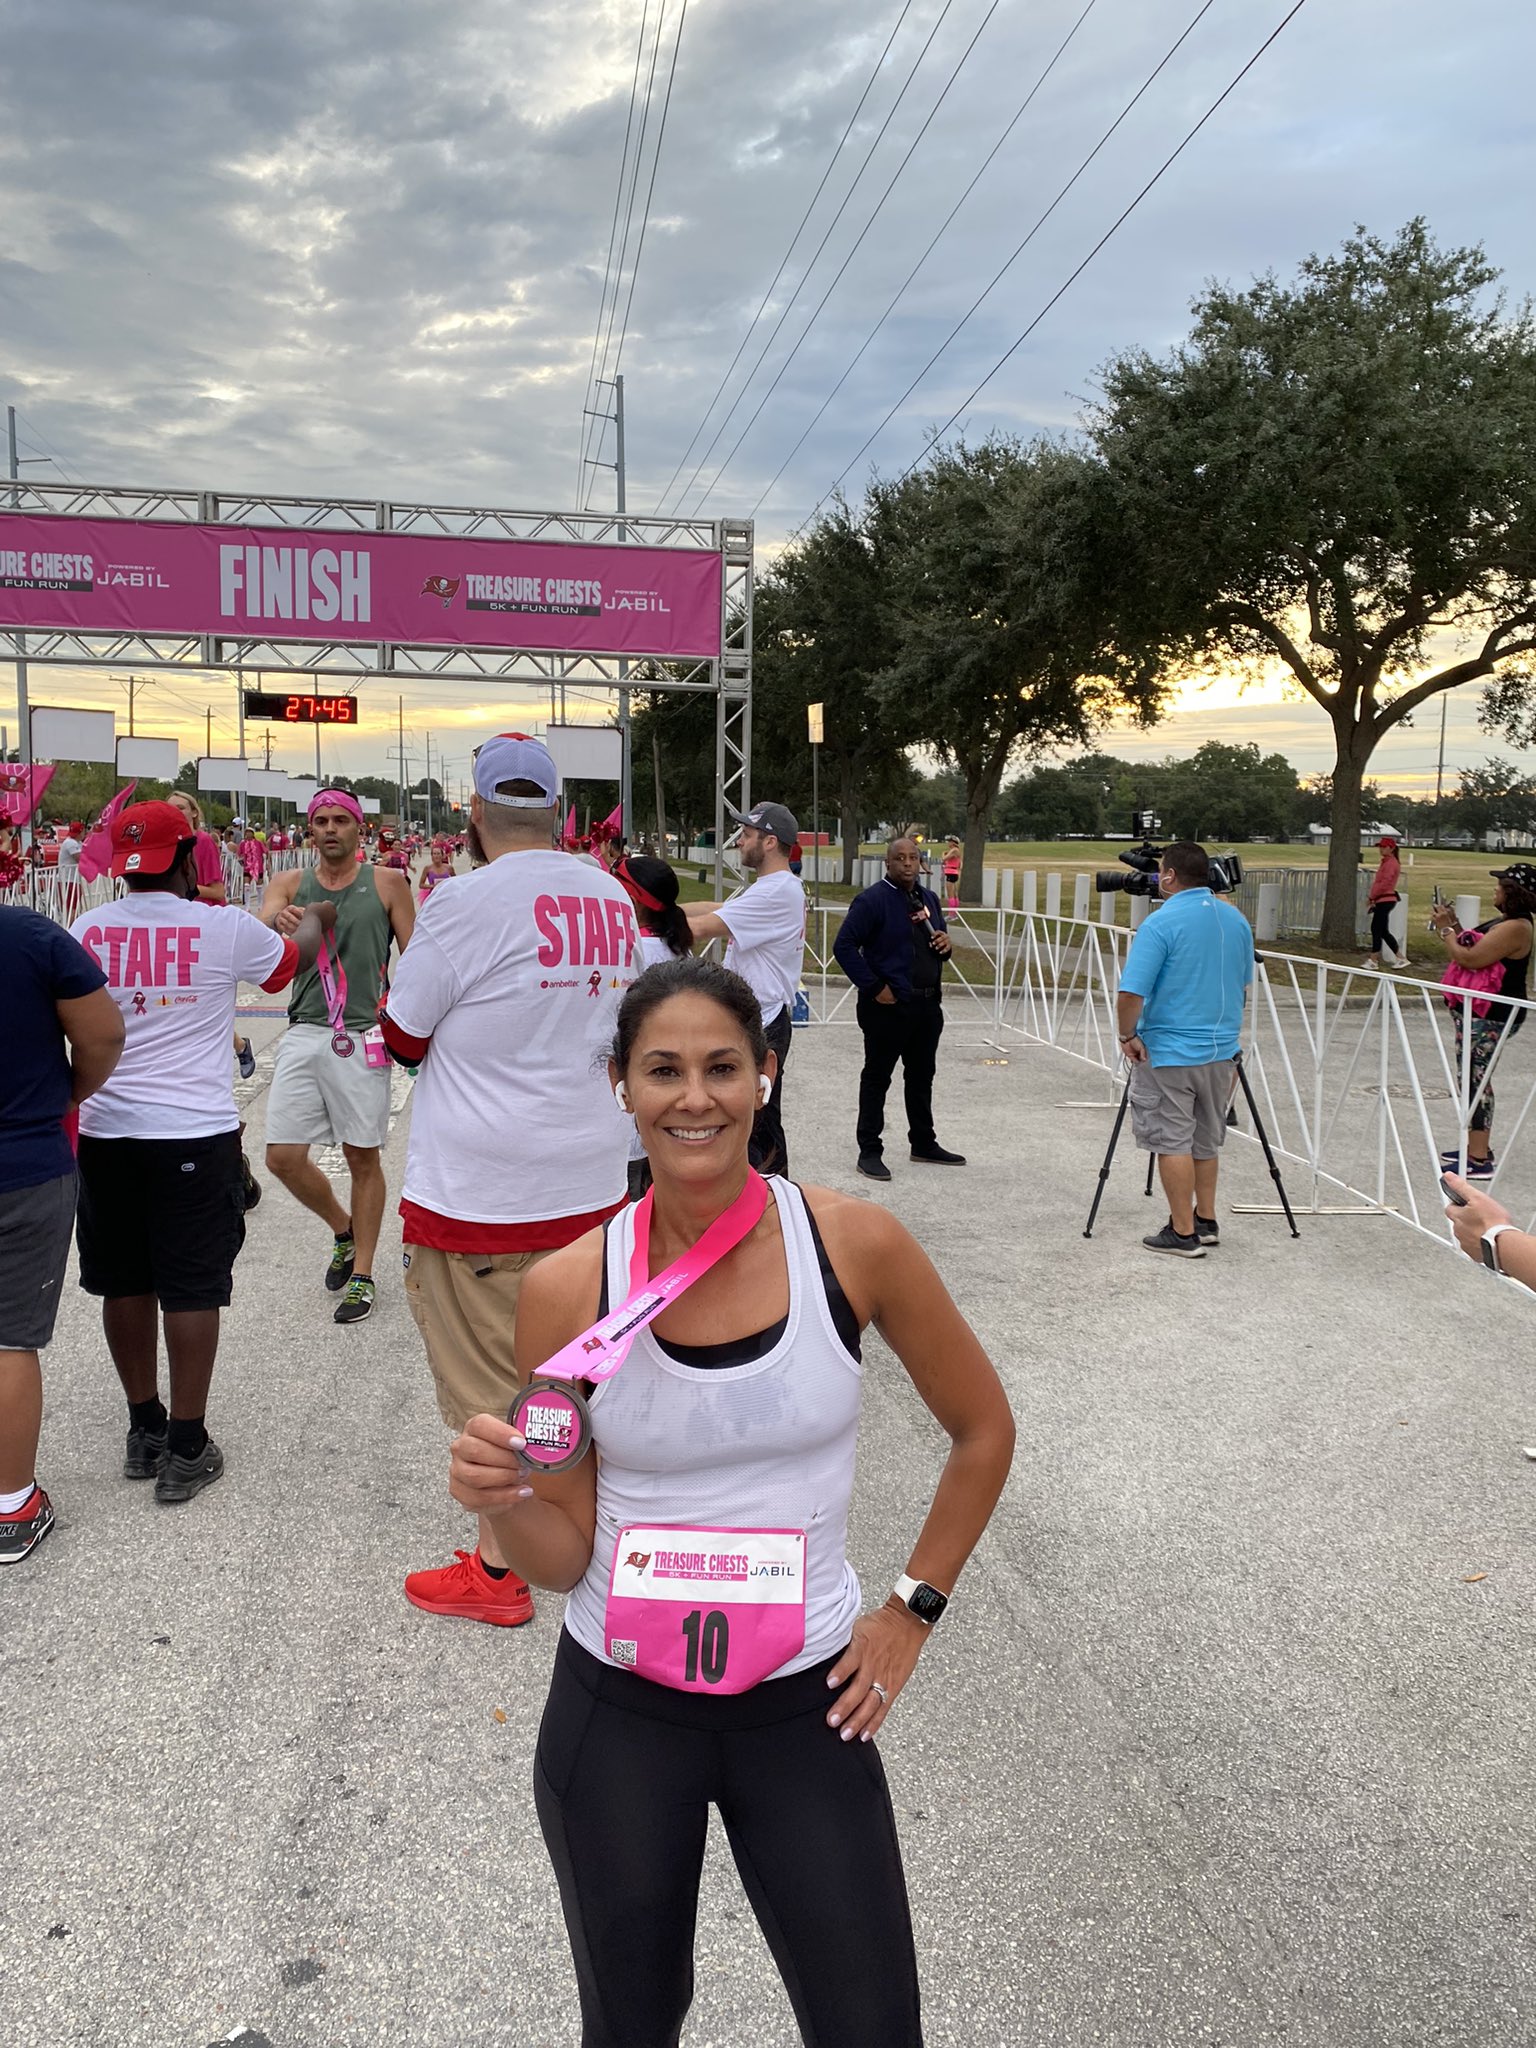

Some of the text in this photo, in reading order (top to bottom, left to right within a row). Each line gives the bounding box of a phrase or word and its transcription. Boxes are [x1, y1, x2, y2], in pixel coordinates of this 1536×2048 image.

[31, 552, 94, 581] CHESTS
[5, 579, 69, 590] FUN RUN
[97, 571, 170, 588] JABIL
[219, 544, 371, 623] FINISH
[466, 574, 602, 606] TREASURE CHESTS
[489, 602, 506, 611] 5K
[521, 604, 548, 613] FUN
[551, 605, 579, 614] RUN
[604, 596, 671, 612] JABIL
[534, 894, 636, 968] STAFF
[82, 925, 200, 987] STAFF
[526, 1406, 573, 1427] TREASURE
[525, 1422, 561, 1441] CHESTS
[655, 1551, 749, 1573] TREASURE CHESTS
[749, 1566, 796, 1577] JABIL
[690, 1572, 710, 1580] FUN
[682, 1610, 730, 1685] 10
